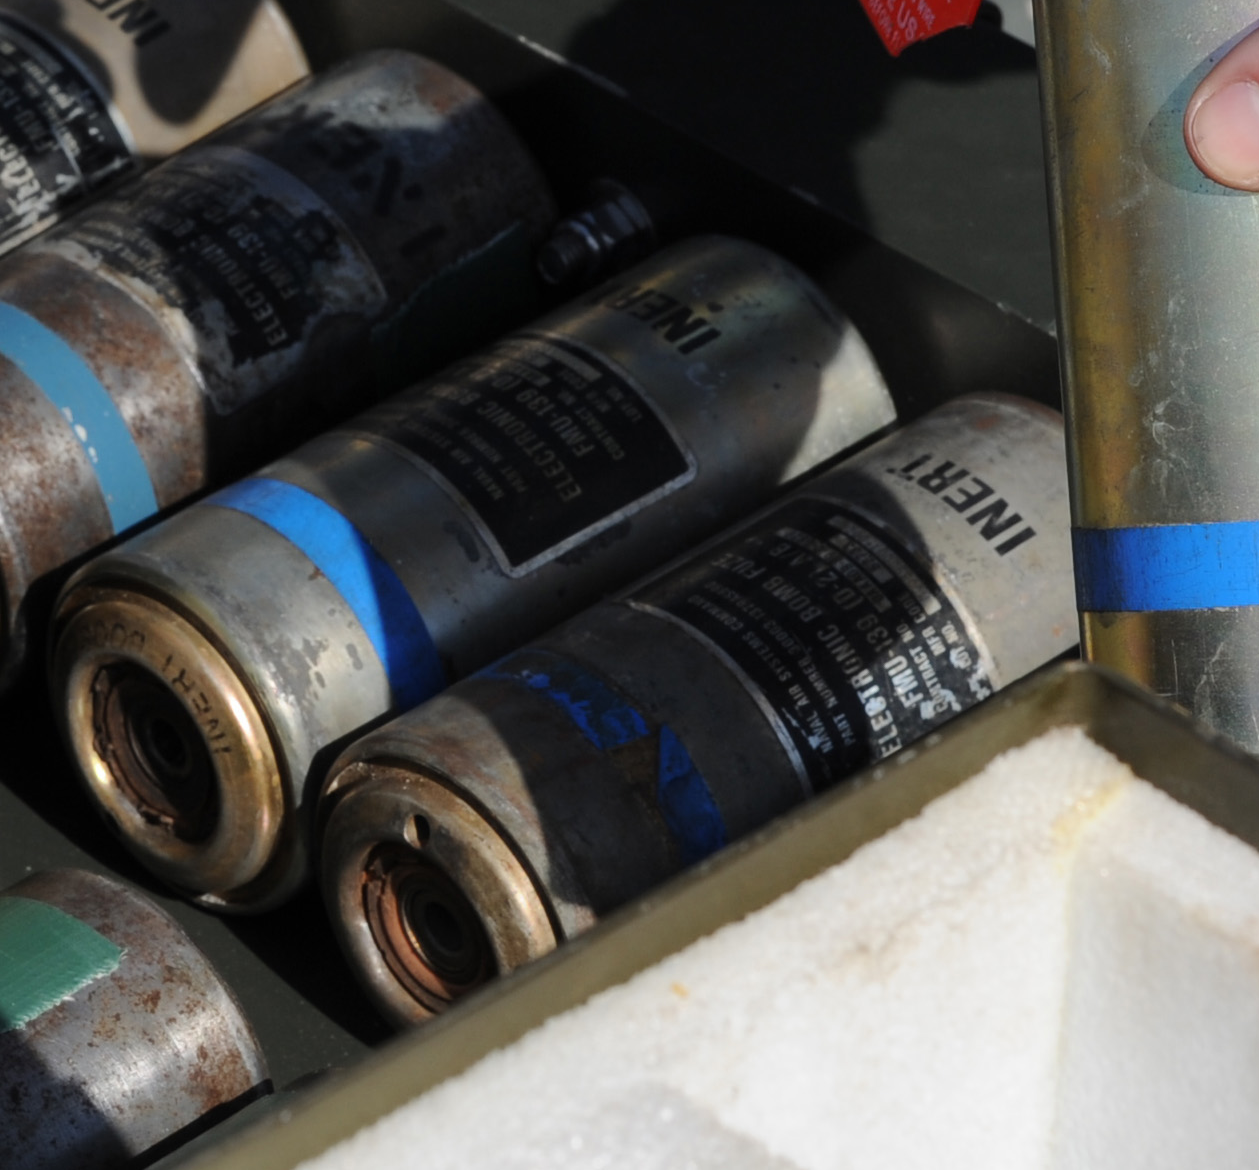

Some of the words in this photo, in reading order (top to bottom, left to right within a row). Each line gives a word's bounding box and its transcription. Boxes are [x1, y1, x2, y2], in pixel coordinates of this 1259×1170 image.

[475, 399, 584, 503] ELECTRONIC
[514, 387, 596, 458] FMU-139
[887, 451, 1037, 557] INERT
[762, 576, 823, 623] BOMB
[741, 630, 793, 683] SYSTEMS
[854, 612, 925, 710] FMU-139
[920, 625, 946, 657] MFR
[788, 683, 811, 712] AIR
[816, 623, 904, 758] ELECTRONIC
[805, 709, 835, 754] NAVAL
